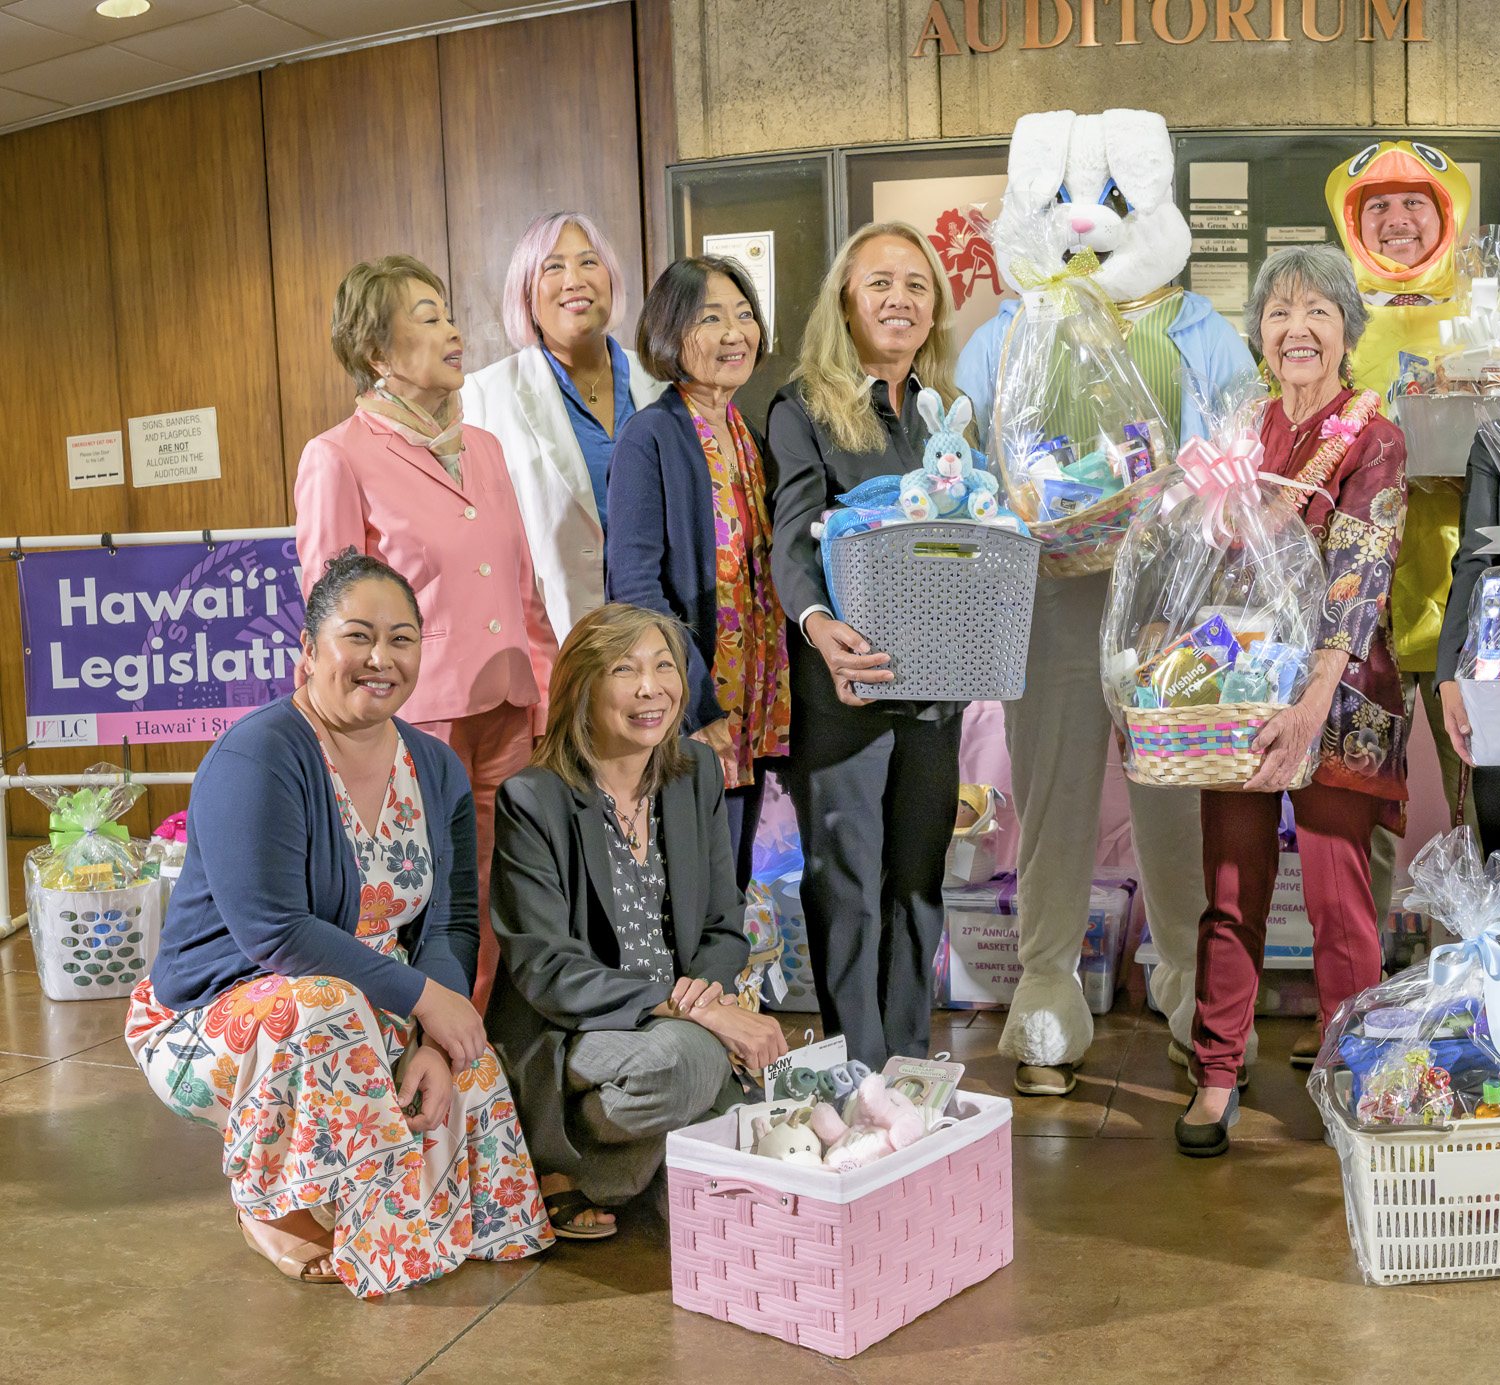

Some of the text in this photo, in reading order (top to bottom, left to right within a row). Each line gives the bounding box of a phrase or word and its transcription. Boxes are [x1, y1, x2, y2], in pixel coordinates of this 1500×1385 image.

[909, 0, 1431, 57] AUDITORIUM
[1200, 245, 1218, 253] Sylvia
[142, 414, 203, 431] SIGNS, BANNERS,
[144, 428, 202, 443] AND FLAGPOLES
[72, 440, 96, 448] EMERGENCY
[158, 442, 189, 453] ARE NOT
[146, 452, 204, 467] ALLOWED IN THE
[154, 466, 198, 479] AUDITORIUM
[1164, 662, 1207, 698] Wishing
[212, 717, 236, 732] St
[1283, 868, 1302, 877] EAS
[1274, 882, 1301, 891] DRIVE
[1270, 903, 1306, 912] ERGEAN
[1266, 916, 1287, 925] RMS
[962, 926, 1020, 938] 27TH ANNUAL
[977, 942, 1010, 952] BASKET
[975, 962, 1005, 971] SENATE
[991, 975, 1001, 983] AT
[767, 1056, 793, 1073] DKNY
